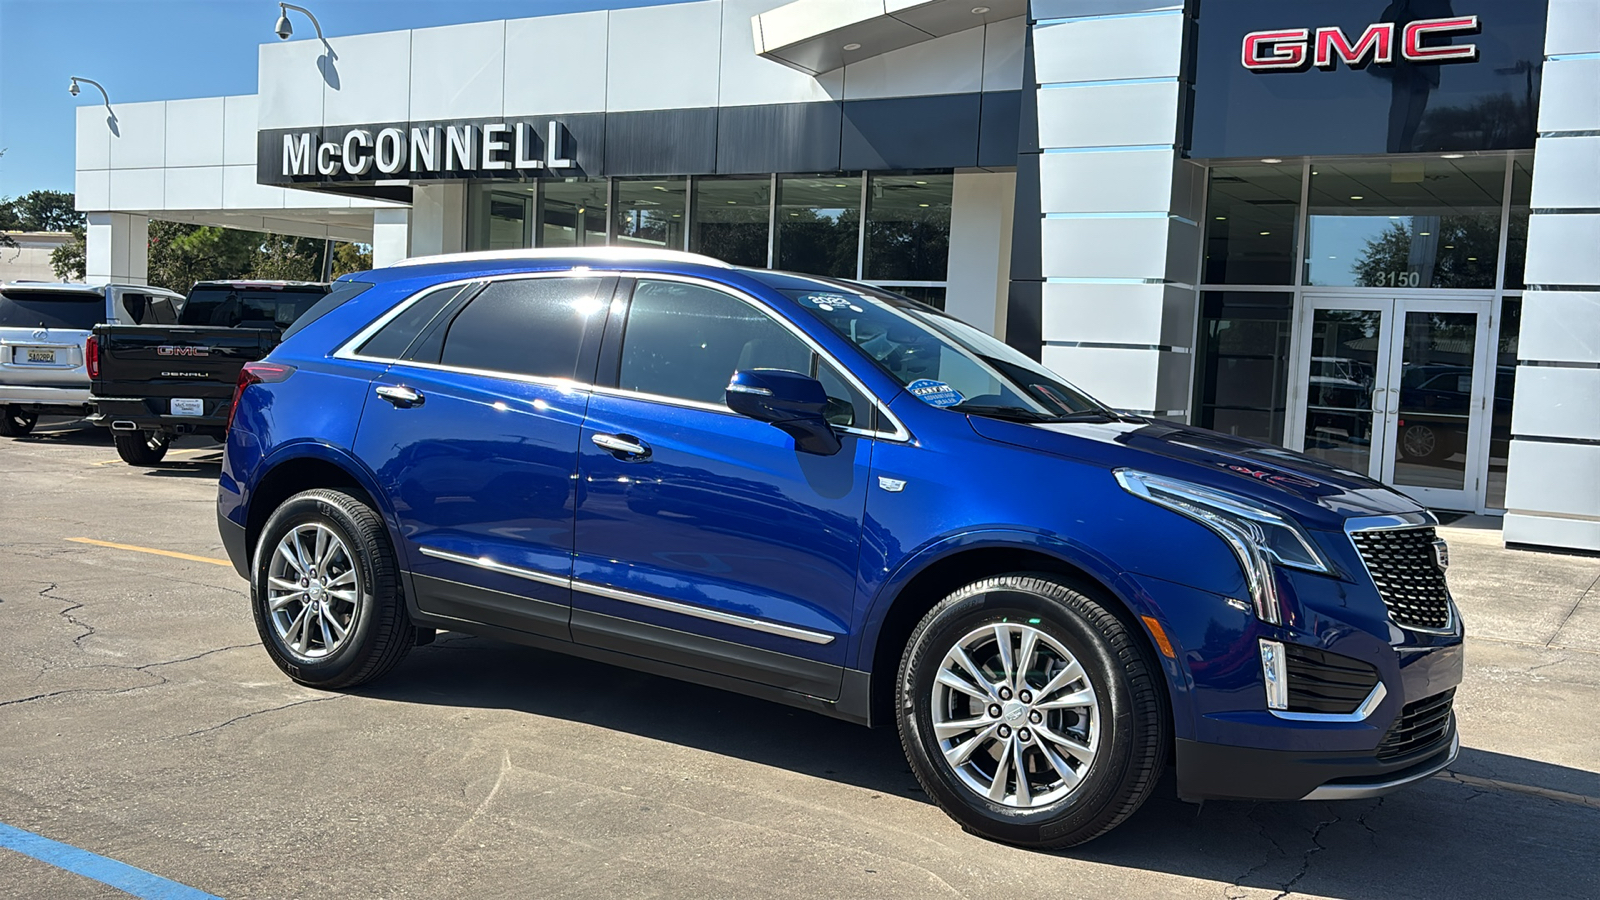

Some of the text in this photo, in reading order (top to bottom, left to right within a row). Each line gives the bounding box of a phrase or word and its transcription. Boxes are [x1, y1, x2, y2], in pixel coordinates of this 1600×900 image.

[1241, 15, 1478, 69] GMC
[282, 120, 574, 177] McCONNELL
[1375, 271, 1421, 288] 3150
[157, 345, 209, 357] GMC
